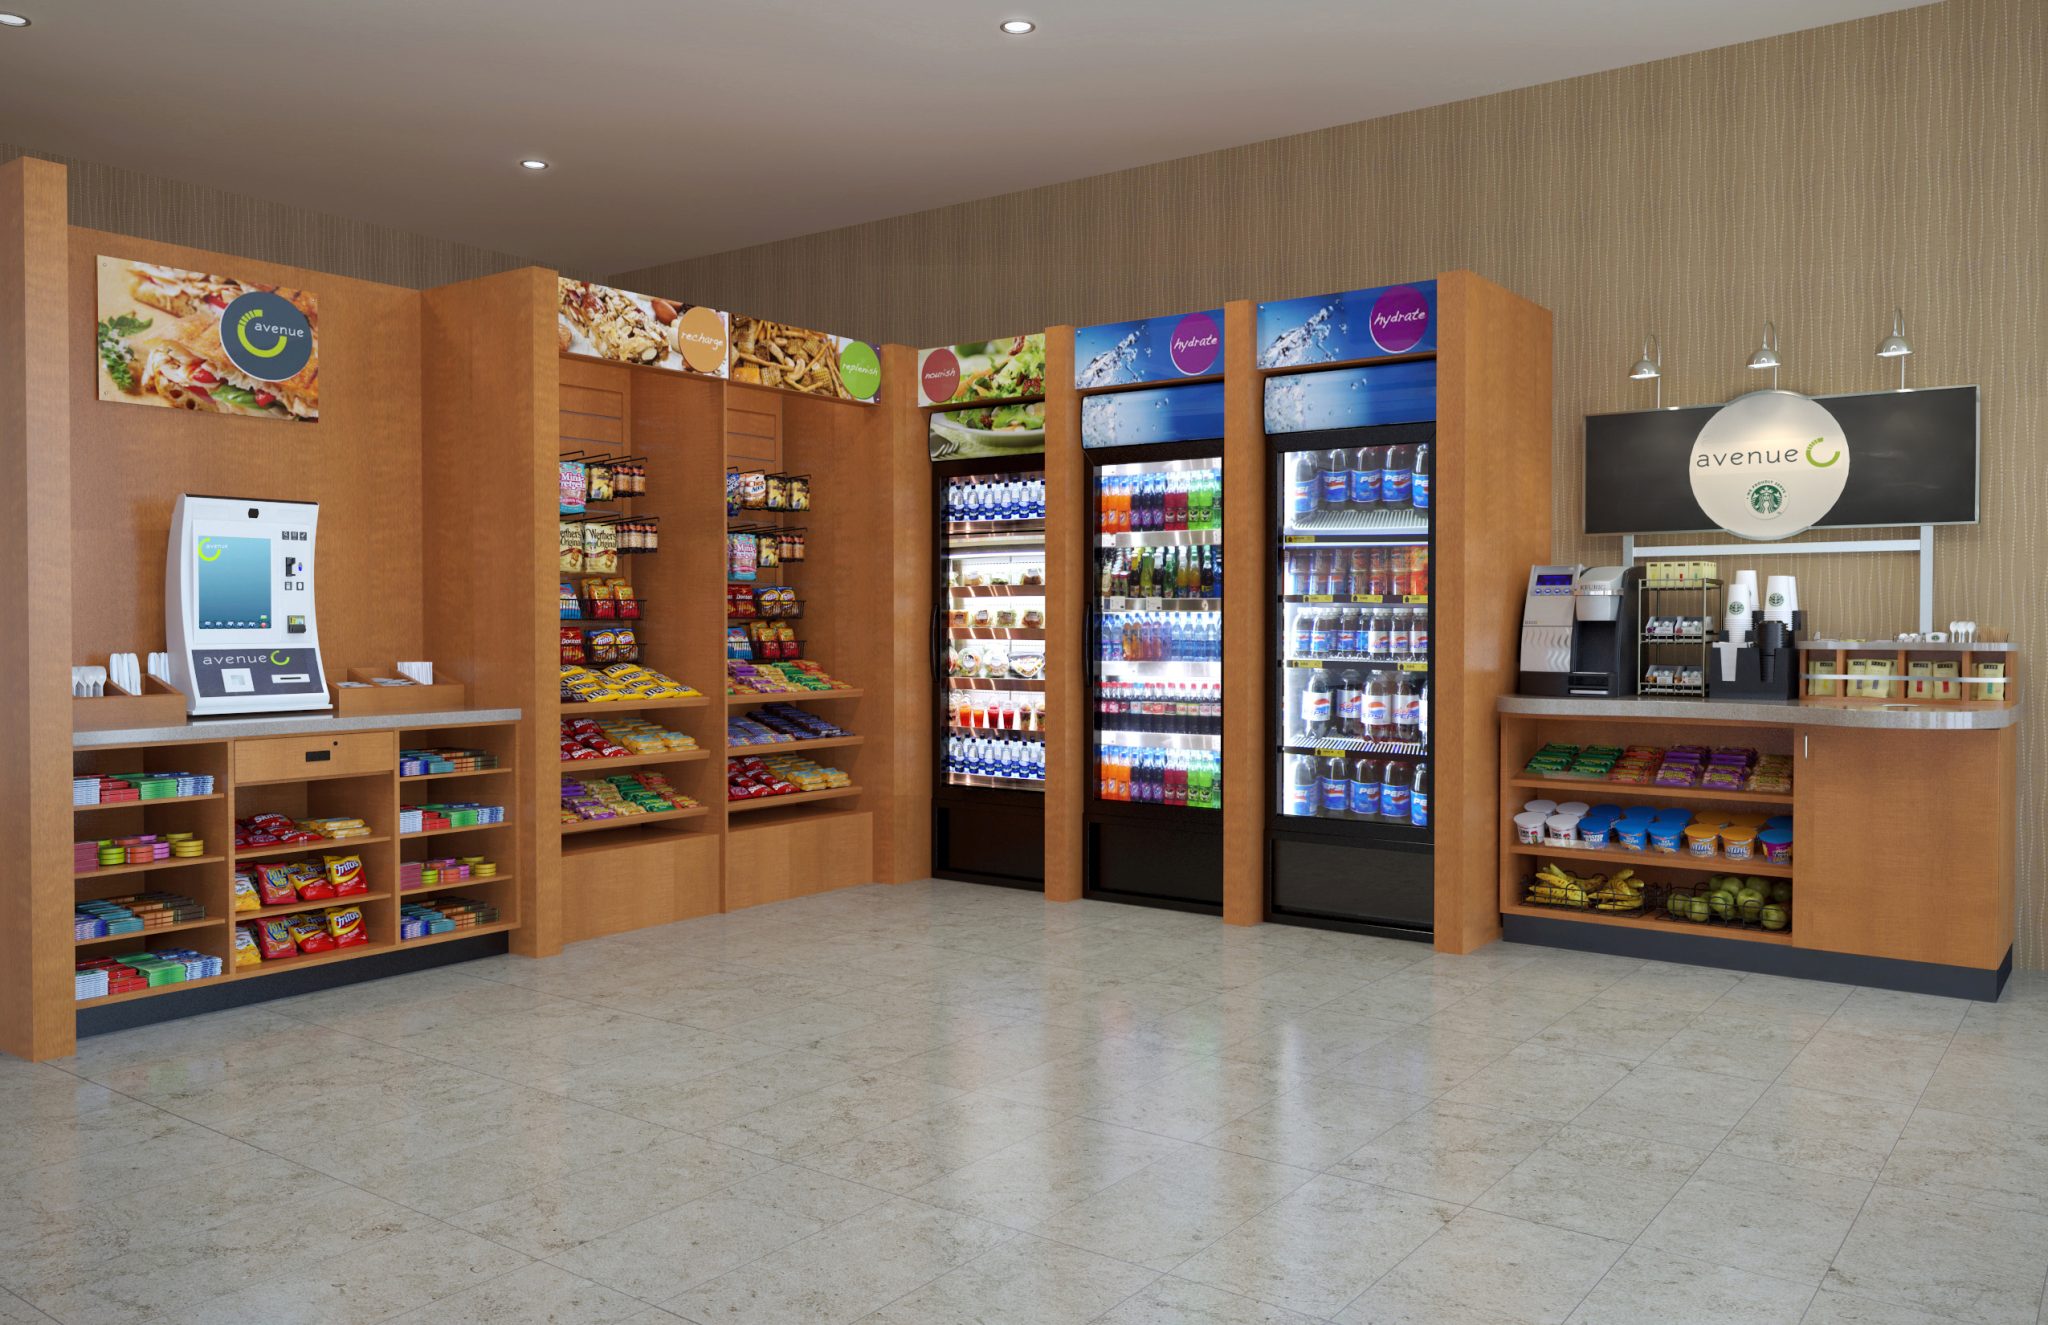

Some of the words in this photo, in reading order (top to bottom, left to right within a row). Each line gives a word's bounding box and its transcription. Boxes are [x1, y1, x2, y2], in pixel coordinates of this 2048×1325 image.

[1374, 308, 1426, 329] hydrate
[254, 322, 305, 338] avenue
[681, 332, 724, 351] recharge
[1174, 334, 1218, 353] hydrate
[842, 363, 878, 376] replenish
[925, 368, 956, 379] nourish
[1696, 448, 1799, 468] avenue
[1360, 474, 1380, 482] PEP
[560, 528, 582, 538] erther's
[203, 654, 268, 665] avenue
[1359, 786, 1379, 794] PEP
[334, 861, 360, 876] Fritos
[334, 911, 360, 928] Fritos
